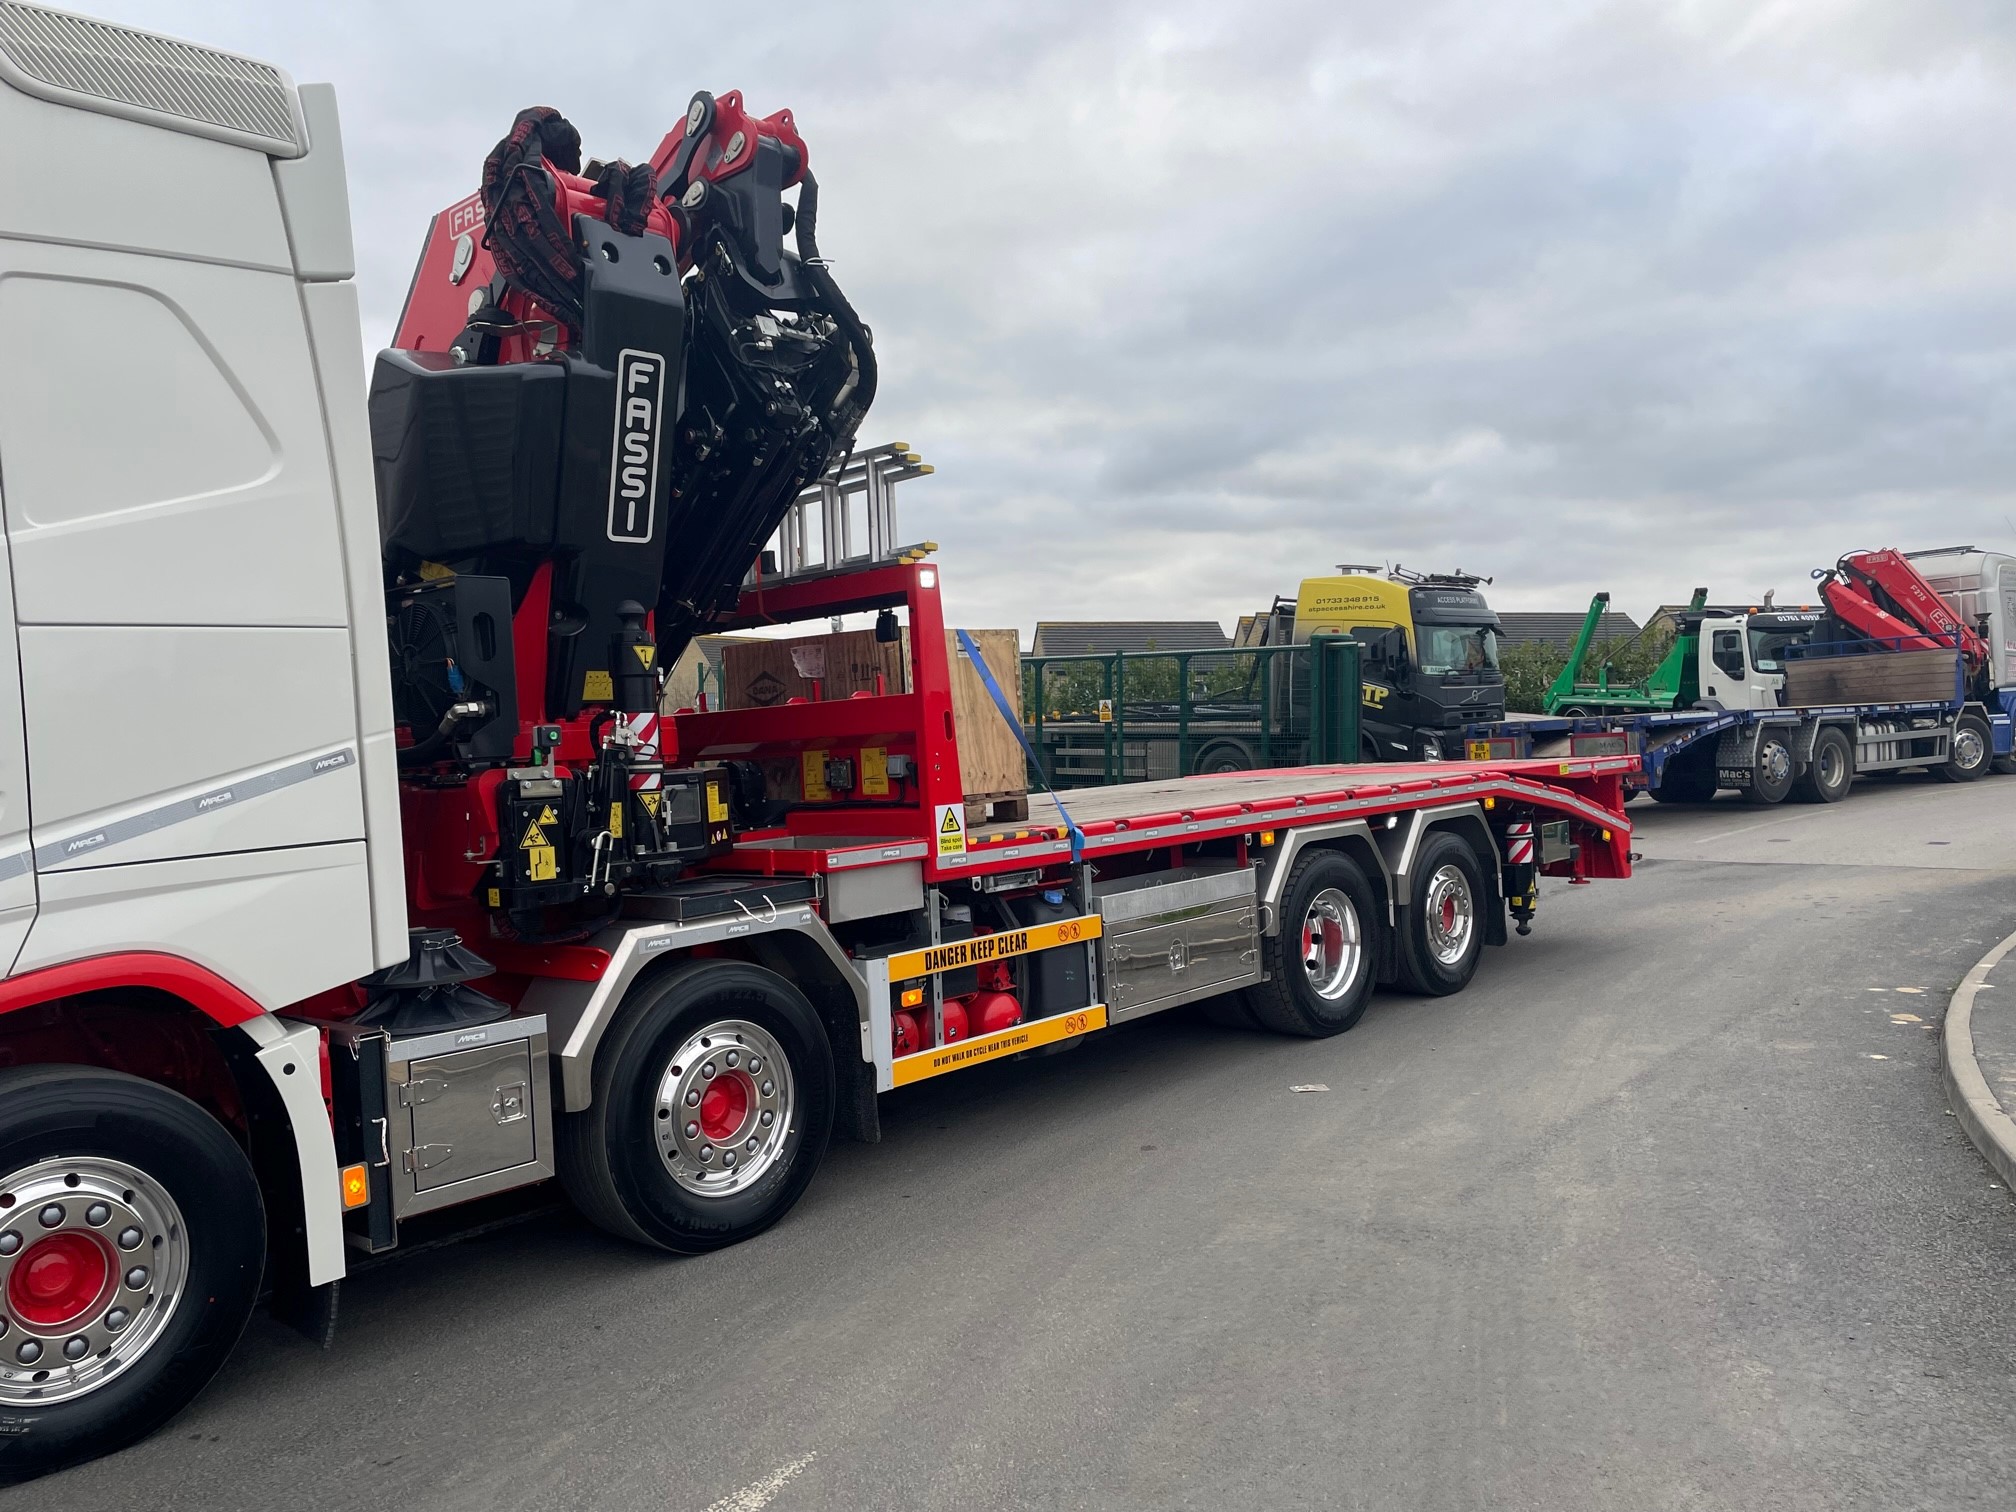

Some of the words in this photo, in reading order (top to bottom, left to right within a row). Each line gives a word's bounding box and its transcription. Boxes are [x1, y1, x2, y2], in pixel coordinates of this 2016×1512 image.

[453, 206, 486, 232] FAS
[620, 361, 655, 532] FASSI
[1437, 596, 1455, 604] ACCESS
[1362, 685, 1390, 702] TP
[1719, 769, 1751, 779] Mac's
[952, 836, 962, 844] spot
[583, 884, 589, 893] 2
[924, 945, 967, 971] DANGER
[970, 939, 995, 962] KEEP
[997, 932, 1028, 955] CLEAR
[933, 1058, 941, 1068] DO
[941, 1055, 951, 1066] NOT
[951, 1051, 965, 1063] WALK
[965, 1049, 973, 1059] OR
[973, 1045, 987, 1057] CYCLE
[987, 1041, 1000, 1053] NEAR
[1000, 1038, 1011, 1049] THIS
[1011, 1033, 1029, 1046] VEHICLE
